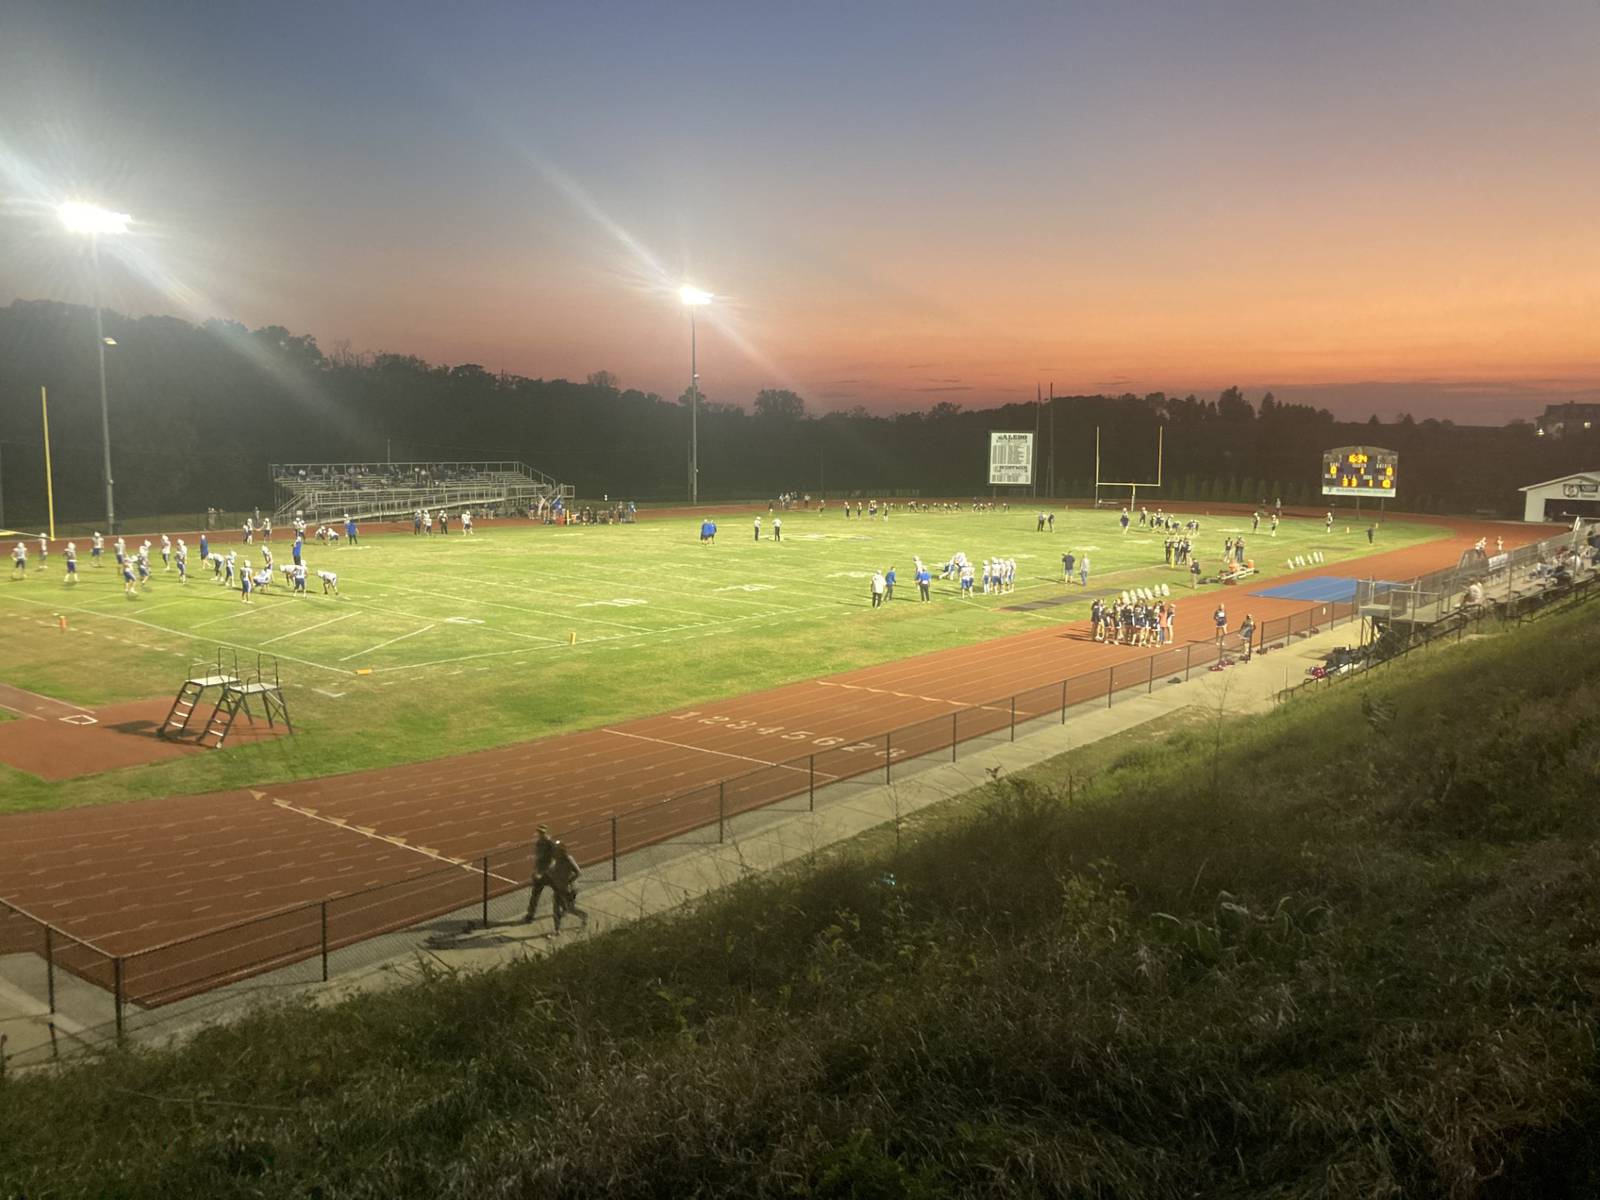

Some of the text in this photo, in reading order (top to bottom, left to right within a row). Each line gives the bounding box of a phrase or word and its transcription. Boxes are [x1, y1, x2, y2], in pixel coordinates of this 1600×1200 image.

[670, 711, 701, 720] 1
[697, 715, 730, 725] 2
[725, 720, 757, 730] 3
[755, 726, 785, 735] 4
[781, 730, 815, 740] 5
[811, 736, 845, 746] 6
